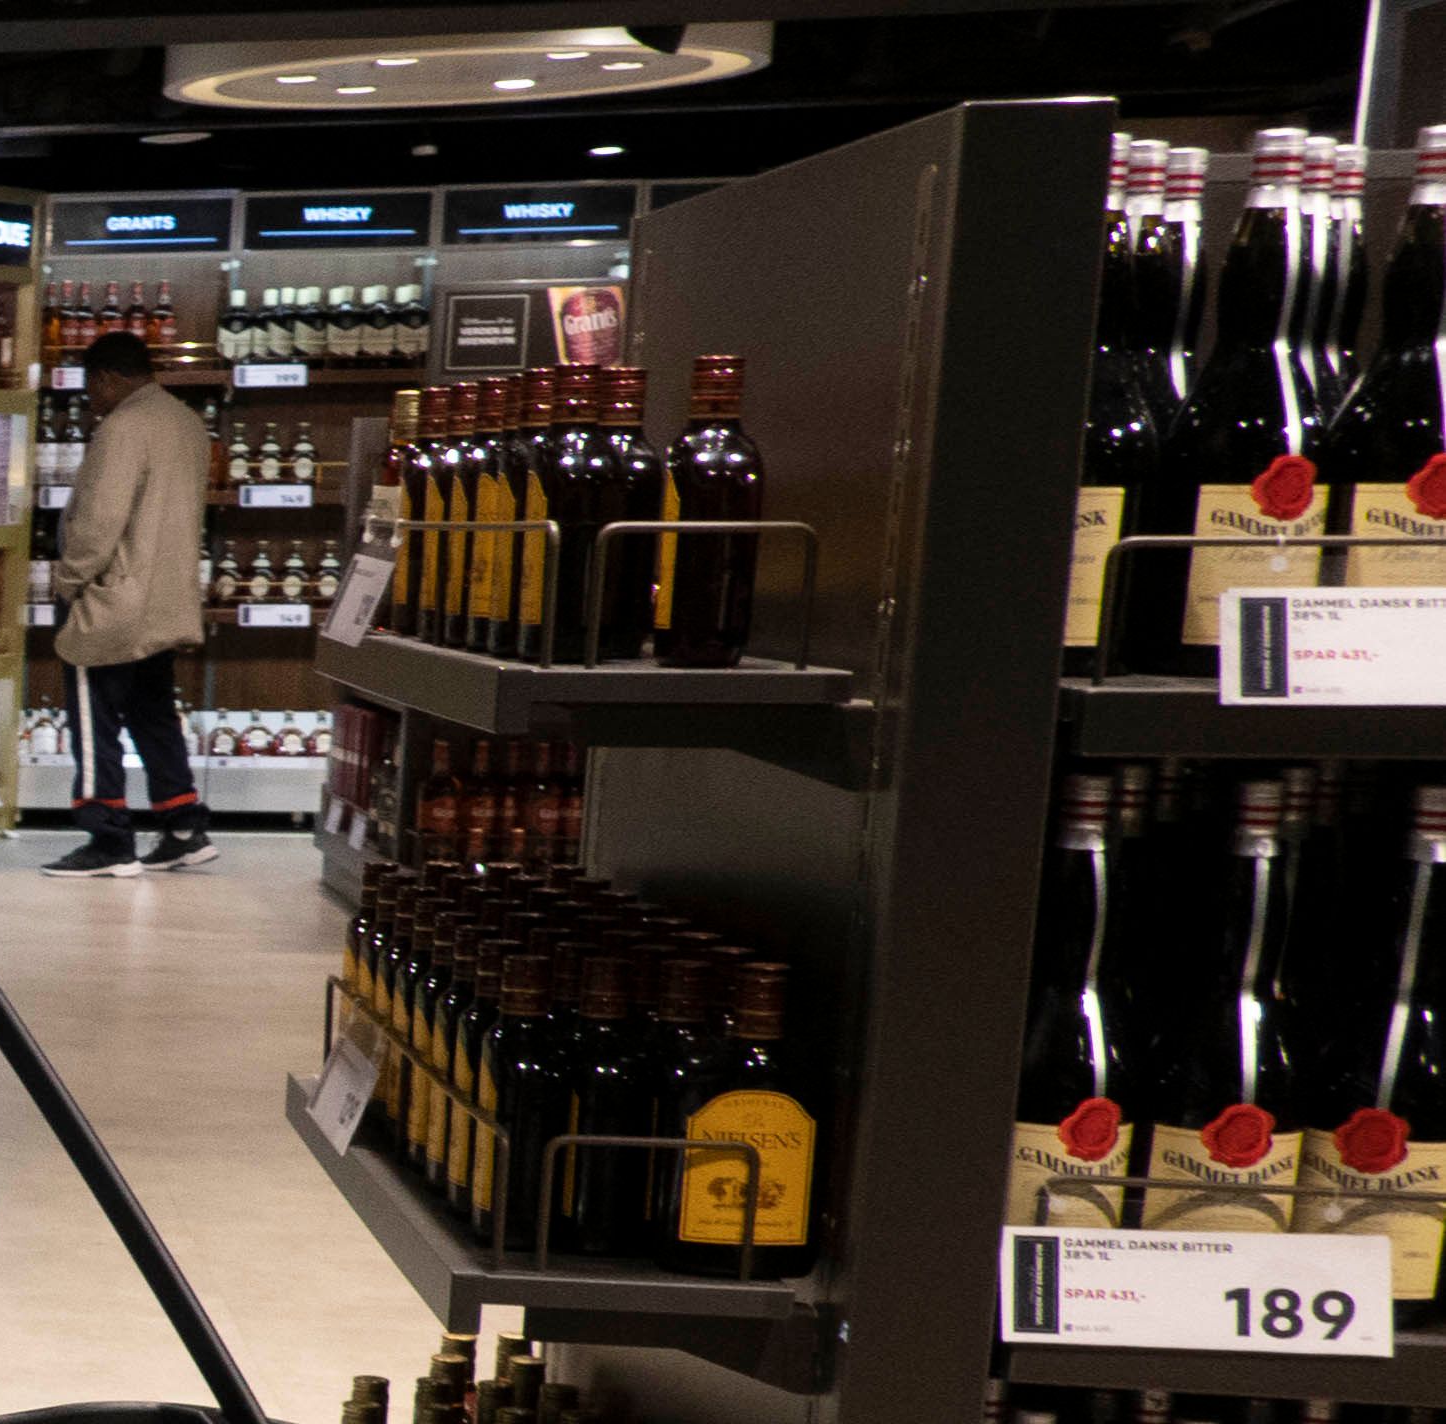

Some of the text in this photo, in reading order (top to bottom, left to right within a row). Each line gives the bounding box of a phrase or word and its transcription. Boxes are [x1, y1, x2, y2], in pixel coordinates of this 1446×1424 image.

[303, 207, 373, 223] WHISKY
[503, 203, 575, 220] WHISKY
[106, 215, 177, 232] GRANTS
[1292, 598, 1355, 609] GAMMEL
[1359, 598, 1411, 609] DANSK
[1293, 649, 1337, 661] SPAR
[1162, 1149, 1247, 1186] GAMMEL
[1063, 1237, 1234, 1255] GAMMEL DANSK BITTER
[1063, 1250, 1095, 1262] 38%
[1064, 1287, 1107, 1301] SPAR
[1223, 1286, 1357, 1341] 189
